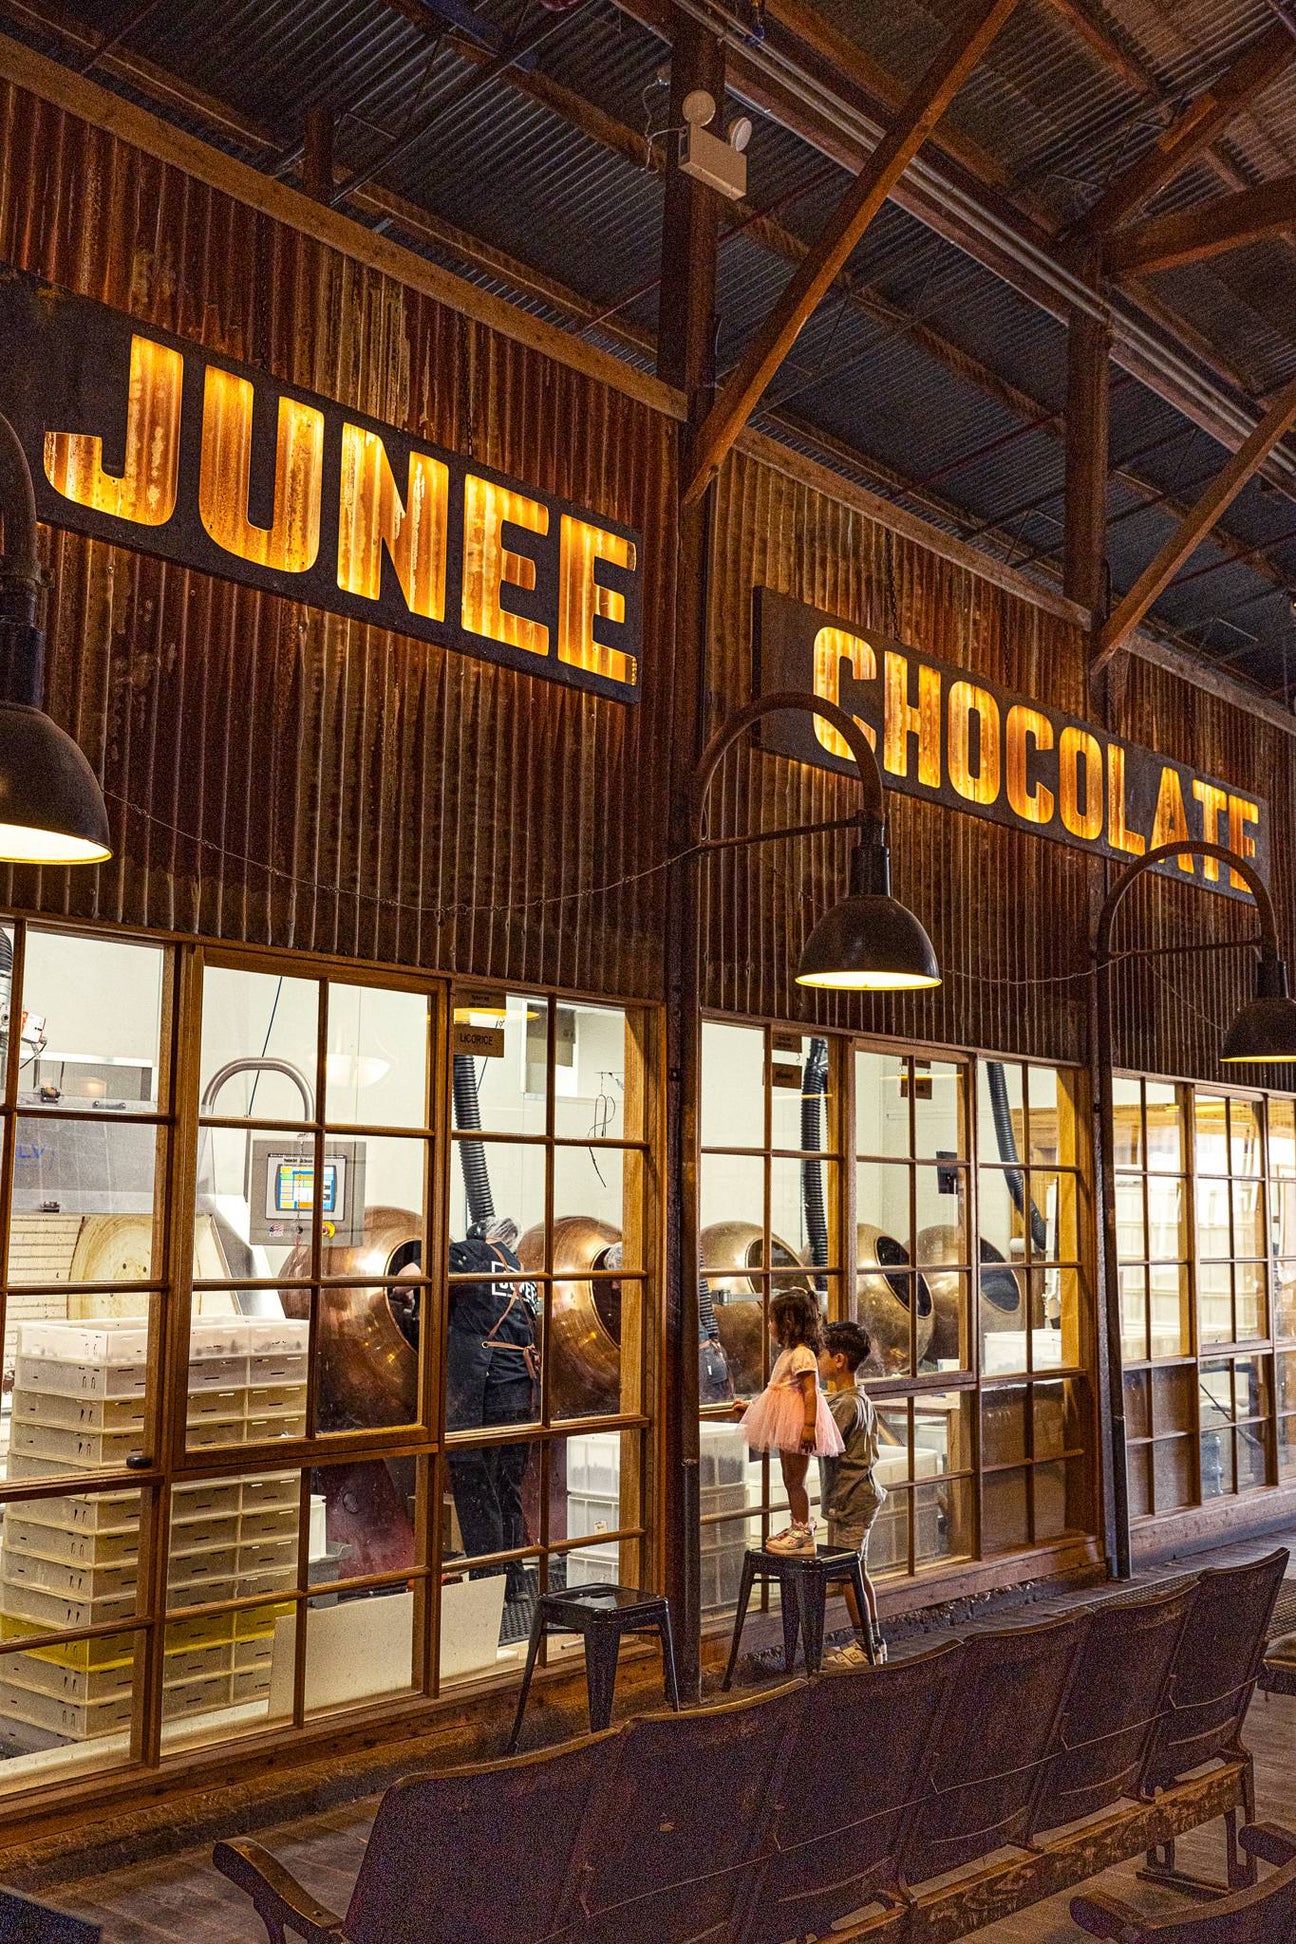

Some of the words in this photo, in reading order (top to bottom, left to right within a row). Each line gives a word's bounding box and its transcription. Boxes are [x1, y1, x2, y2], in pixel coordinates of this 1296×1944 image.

[43, 334, 637, 685] JUNEE
[813, 626, 1260, 894] CHOCOLATE
[460, 1033, 493, 1046] LICORICE
